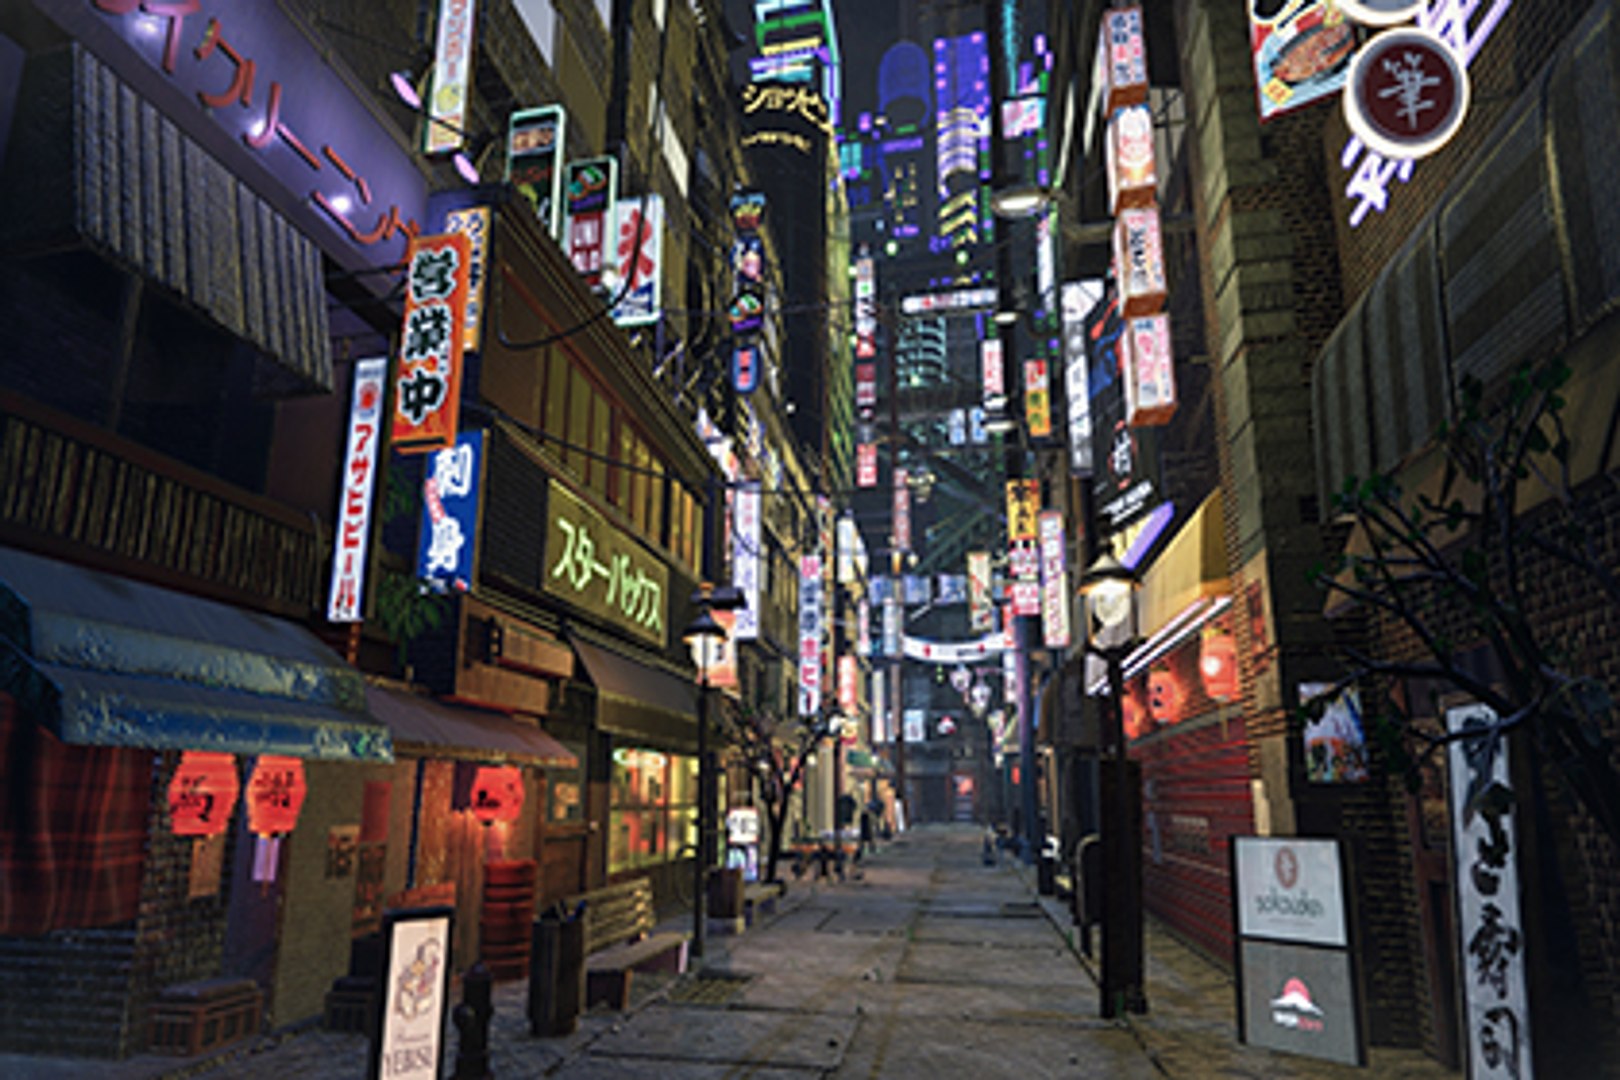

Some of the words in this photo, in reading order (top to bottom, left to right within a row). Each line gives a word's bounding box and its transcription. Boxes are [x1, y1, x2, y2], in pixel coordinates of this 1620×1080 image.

[397, 246, 459, 426] 営業中
[334, 423, 374, 608] アサヒビール
